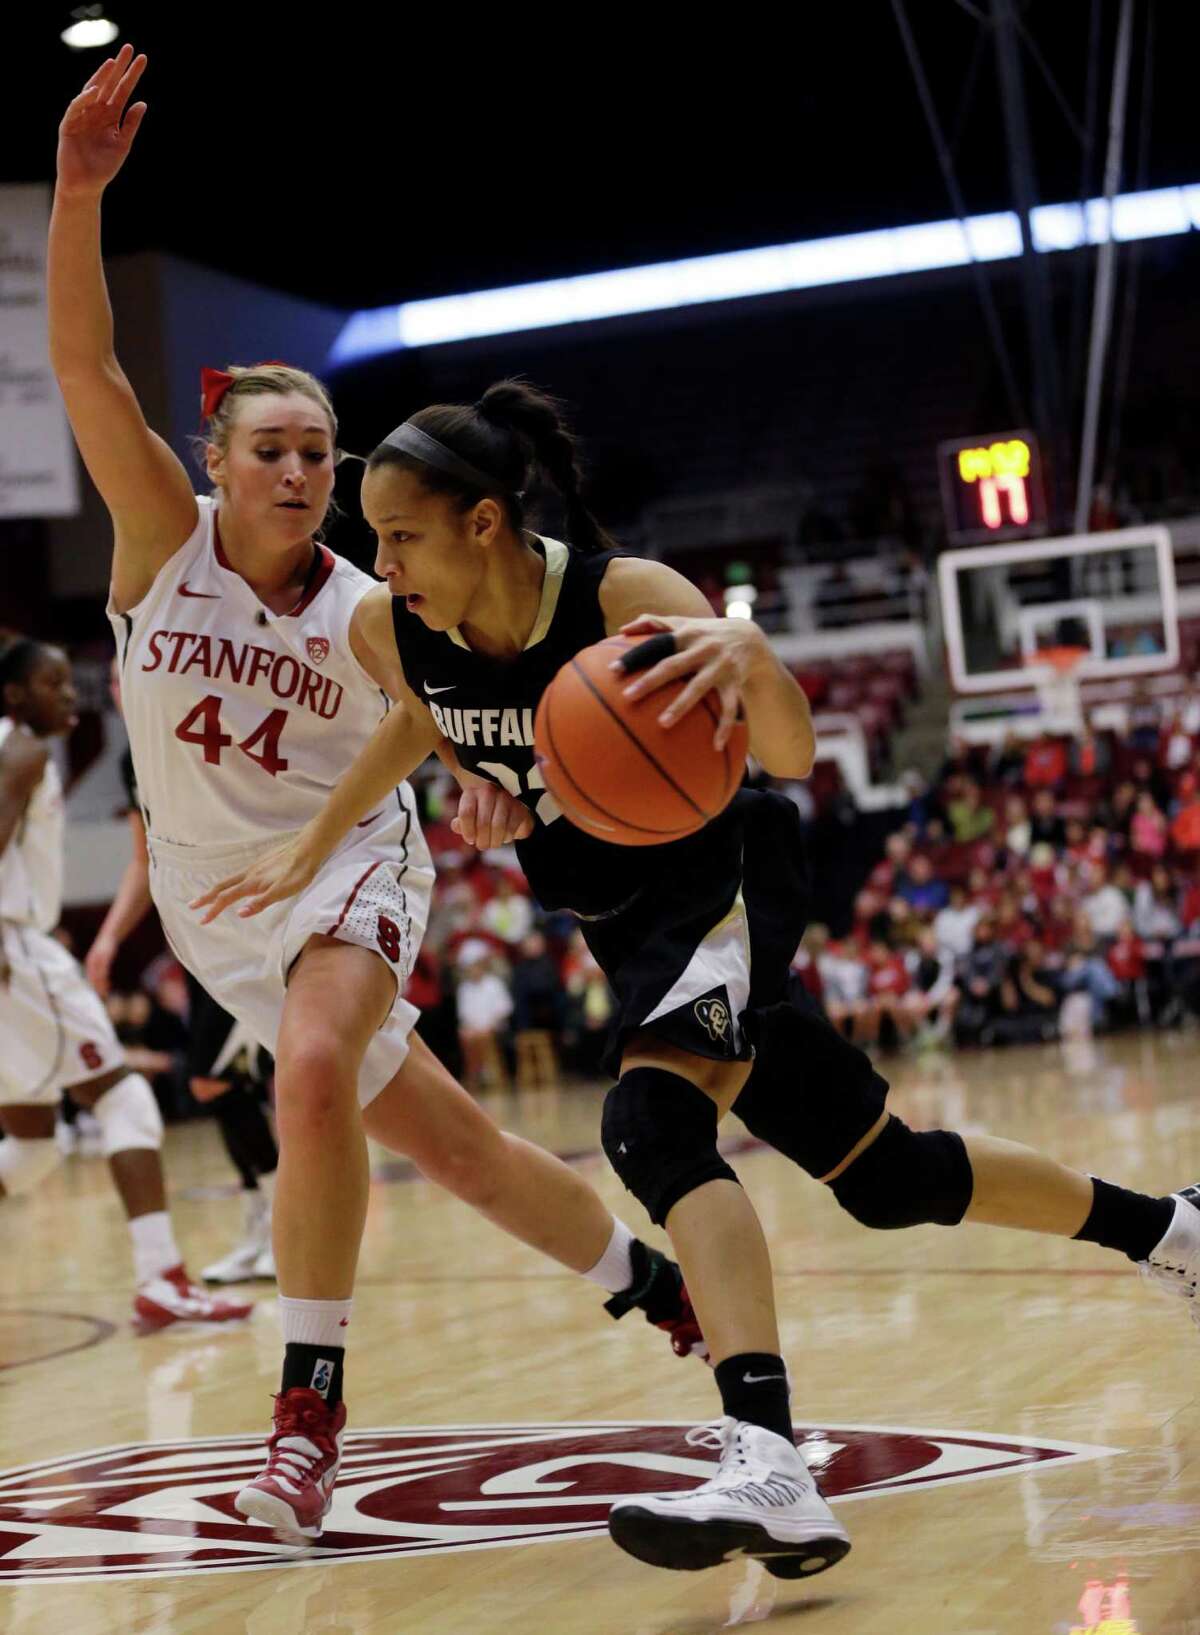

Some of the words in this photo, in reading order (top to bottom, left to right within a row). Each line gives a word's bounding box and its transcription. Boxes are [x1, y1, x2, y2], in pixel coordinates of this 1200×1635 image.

[141, 629, 344, 720] STANFORD
[175, 694, 289, 777] 44
[429, 700, 536, 747] BUFFAL
